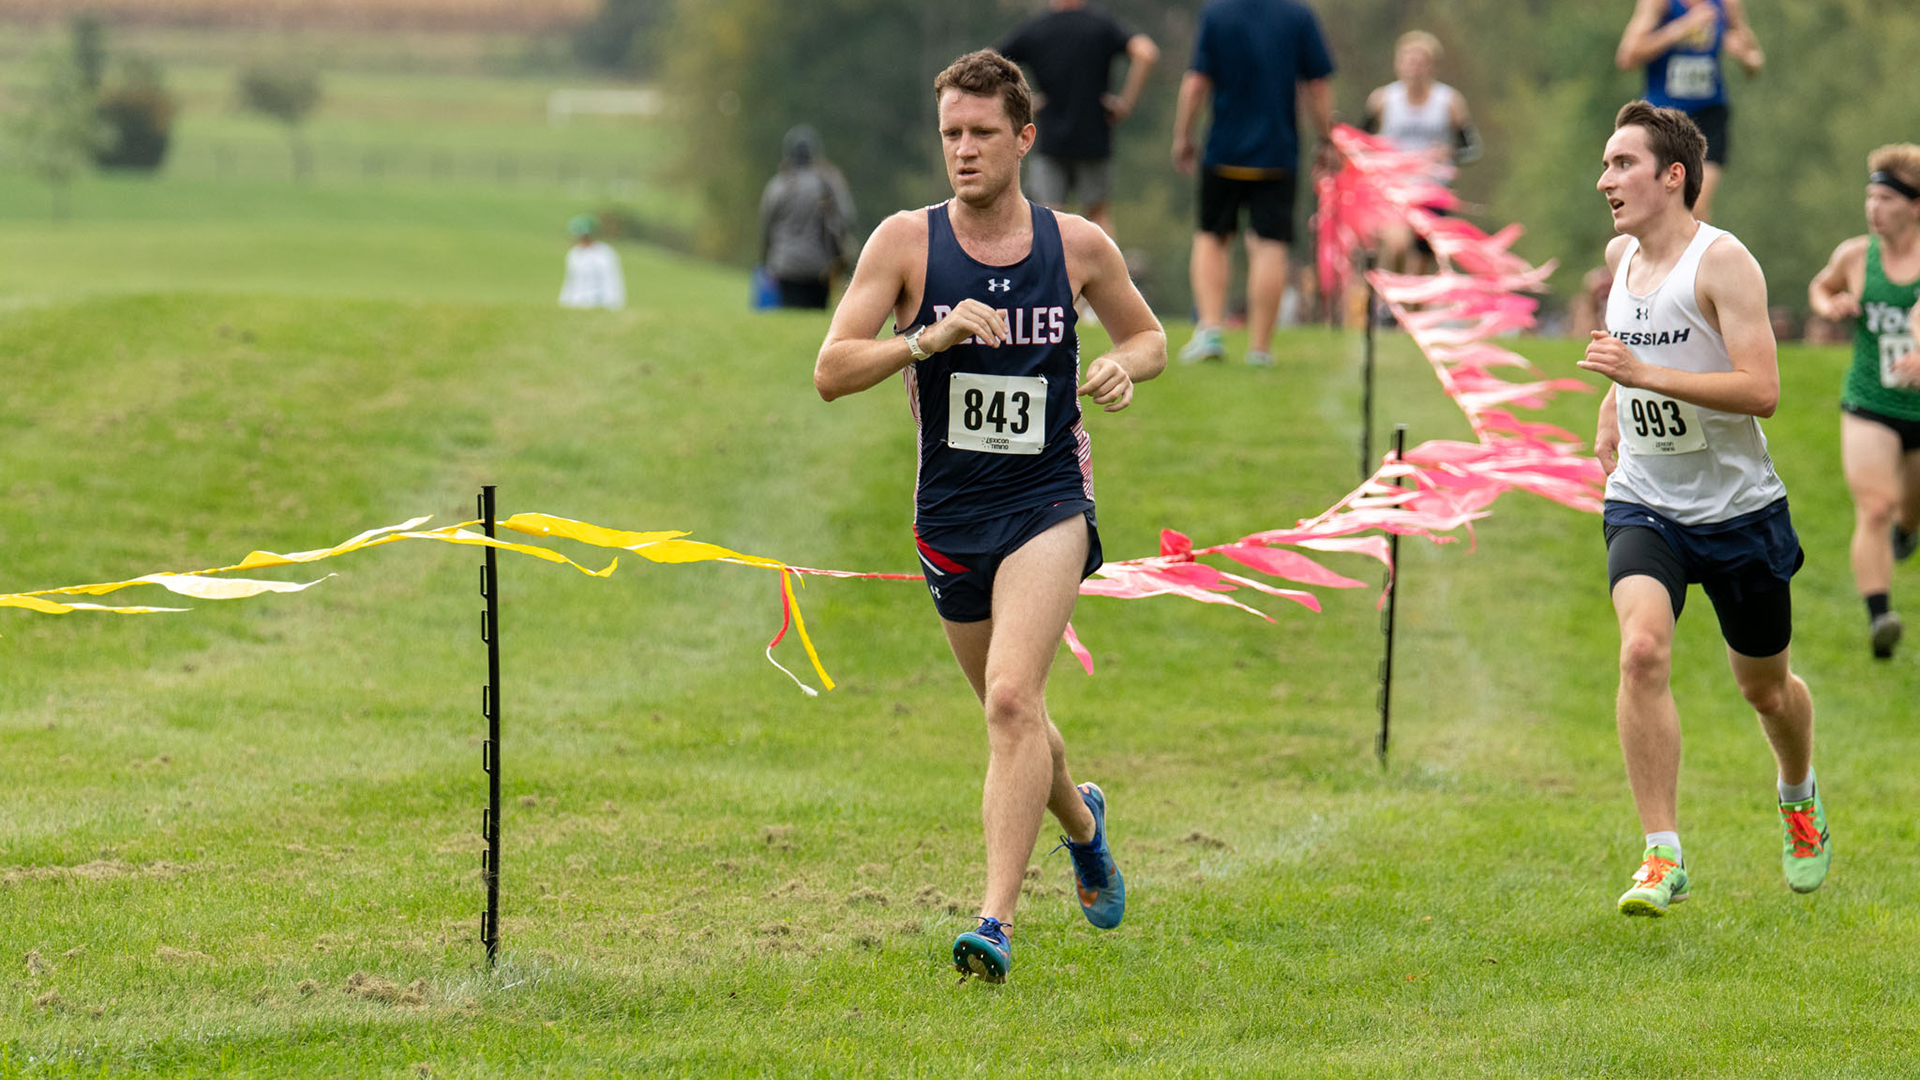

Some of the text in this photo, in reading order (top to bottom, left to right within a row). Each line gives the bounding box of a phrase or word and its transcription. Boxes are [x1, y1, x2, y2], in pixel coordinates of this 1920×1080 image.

[933, 305, 1065, 345] ALES
[1608, 327, 1691, 346] ESSIAH
[964, 388, 1030, 434] 843
[1631, 398, 1687, 437] 993
